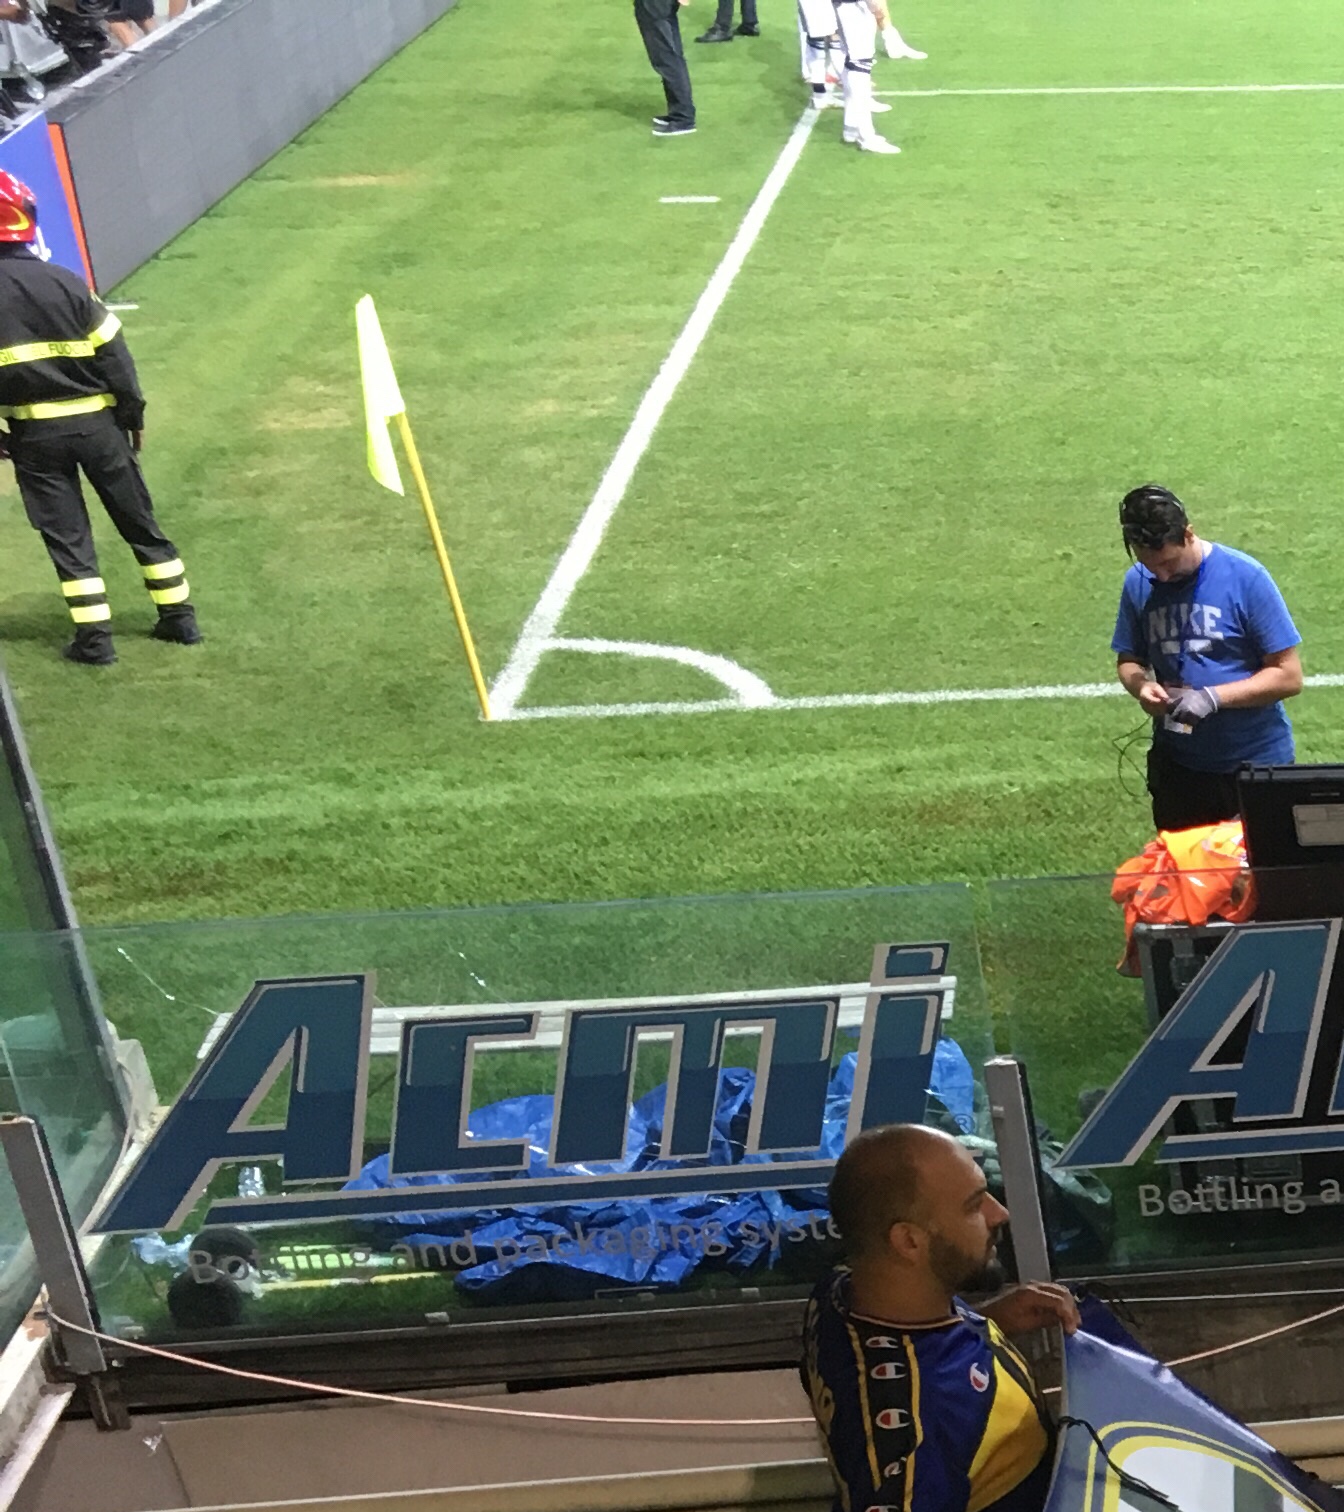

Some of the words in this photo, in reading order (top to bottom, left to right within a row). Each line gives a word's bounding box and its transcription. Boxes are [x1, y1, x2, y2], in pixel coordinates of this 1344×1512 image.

[1148, 603, 1224, 643] NIKE
[1138, 1176, 1307, 1217] Bottling
[392, 1229, 473, 1268] and
[493, 1217, 730, 1268] packaging
[740, 1206, 843, 1250] syste
